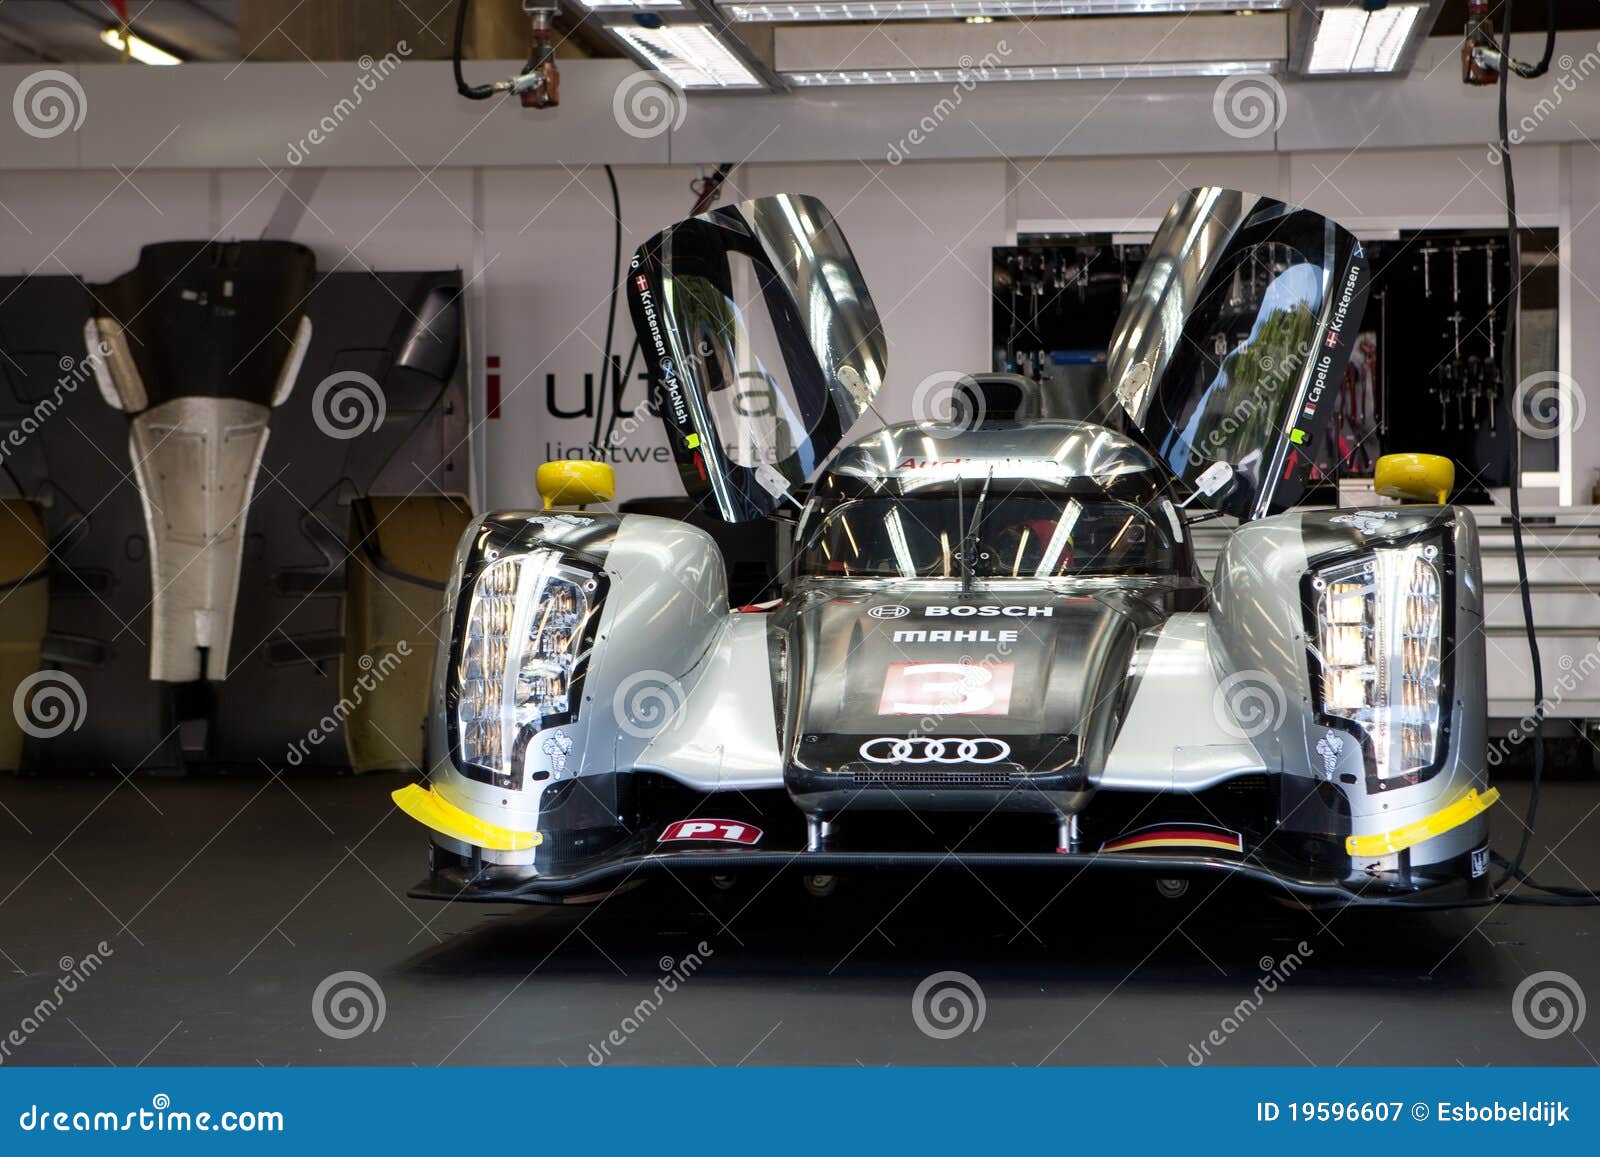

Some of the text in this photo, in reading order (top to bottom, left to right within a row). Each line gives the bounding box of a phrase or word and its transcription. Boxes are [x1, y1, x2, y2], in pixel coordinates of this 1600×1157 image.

[1308, 265, 1361, 403] Capello Kristensen
[640, 289, 667, 356] Kristensen
[666, 378, 688, 424] McNish
[924, 605, 1054, 617] BOSCH
[892, 630, 1018, 642] MAHLE
[894, 663, 995, 715] 3
[676, 822, 745, 840] P1
